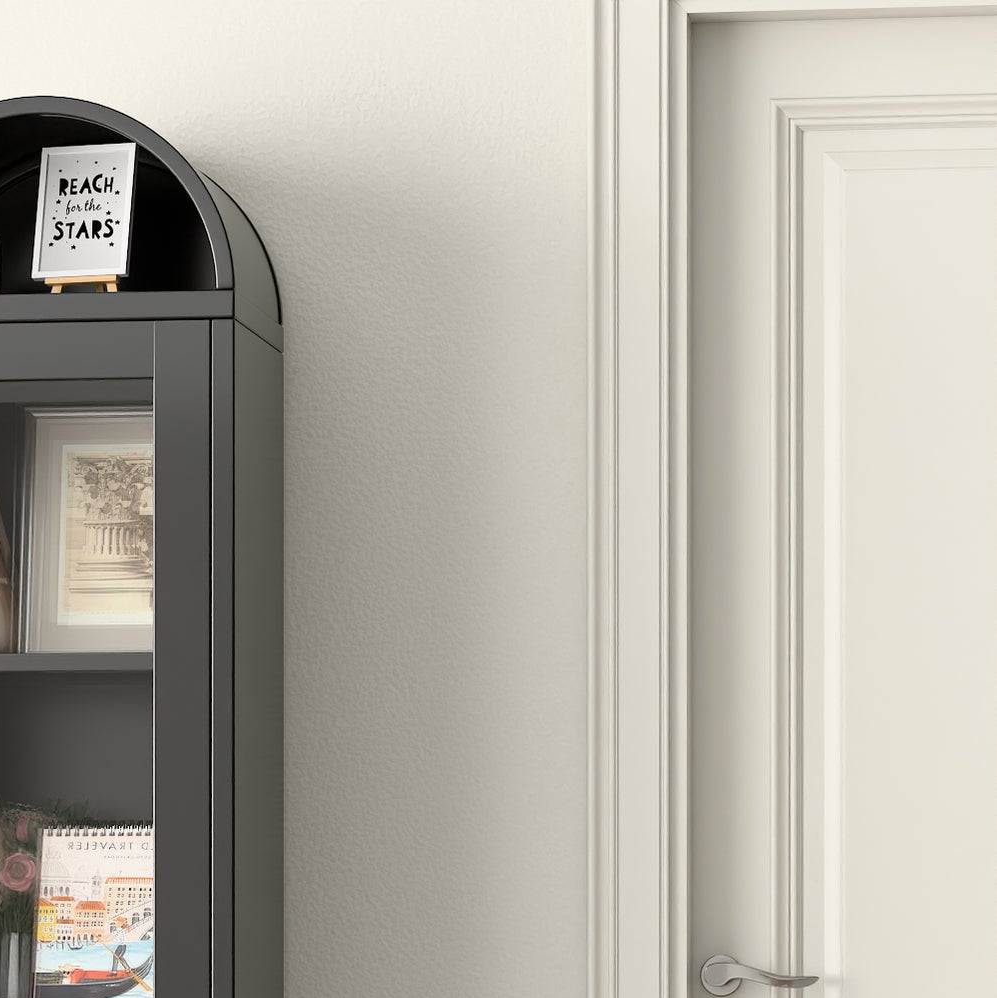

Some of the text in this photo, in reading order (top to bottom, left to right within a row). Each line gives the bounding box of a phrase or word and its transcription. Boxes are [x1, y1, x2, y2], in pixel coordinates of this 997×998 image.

[59, 173, 114, 196] REACH
[65, 198, 103, 215] for the
[53, 218, 114, 241] STARS
